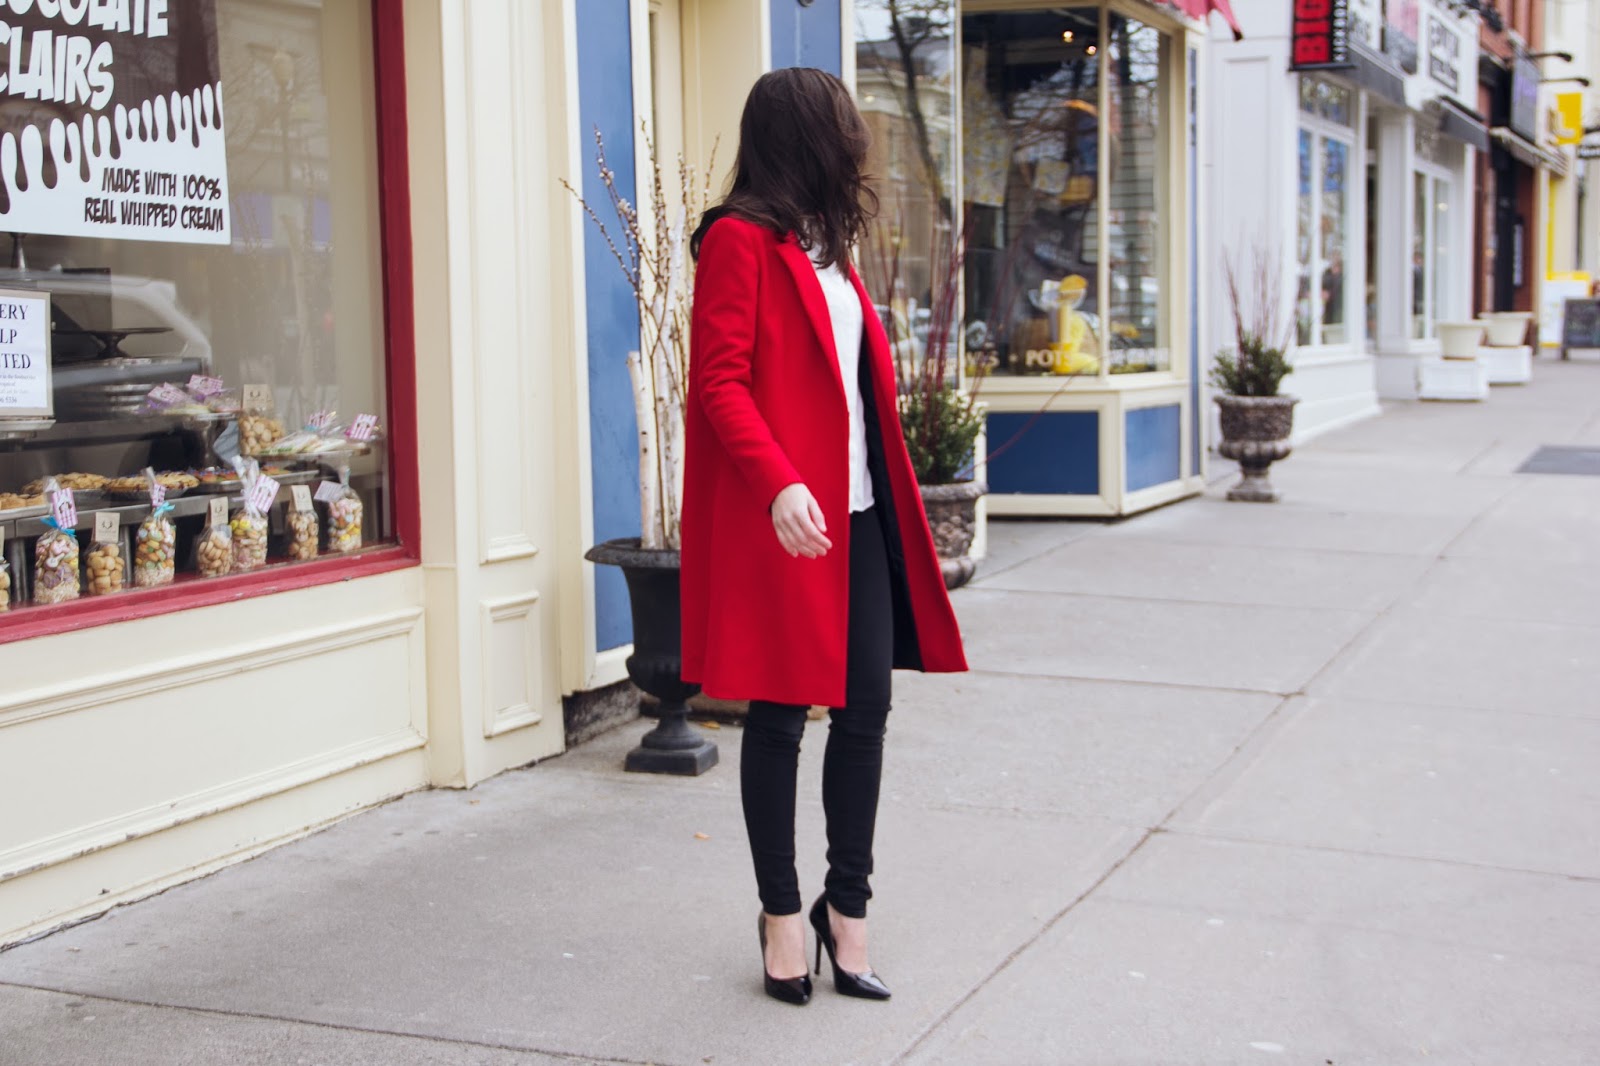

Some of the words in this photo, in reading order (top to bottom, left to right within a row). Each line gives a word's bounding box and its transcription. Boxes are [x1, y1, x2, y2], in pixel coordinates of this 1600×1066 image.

[102, 167, 140, 194] MADE
[145, 170, 177, 197] WITH
[183, 174, 222, 201] 100%
[84, 197, 117, 224] REAL
[121, 199, 177, 228] WHIPPED
[181, 205, 224, 232] CREAM
